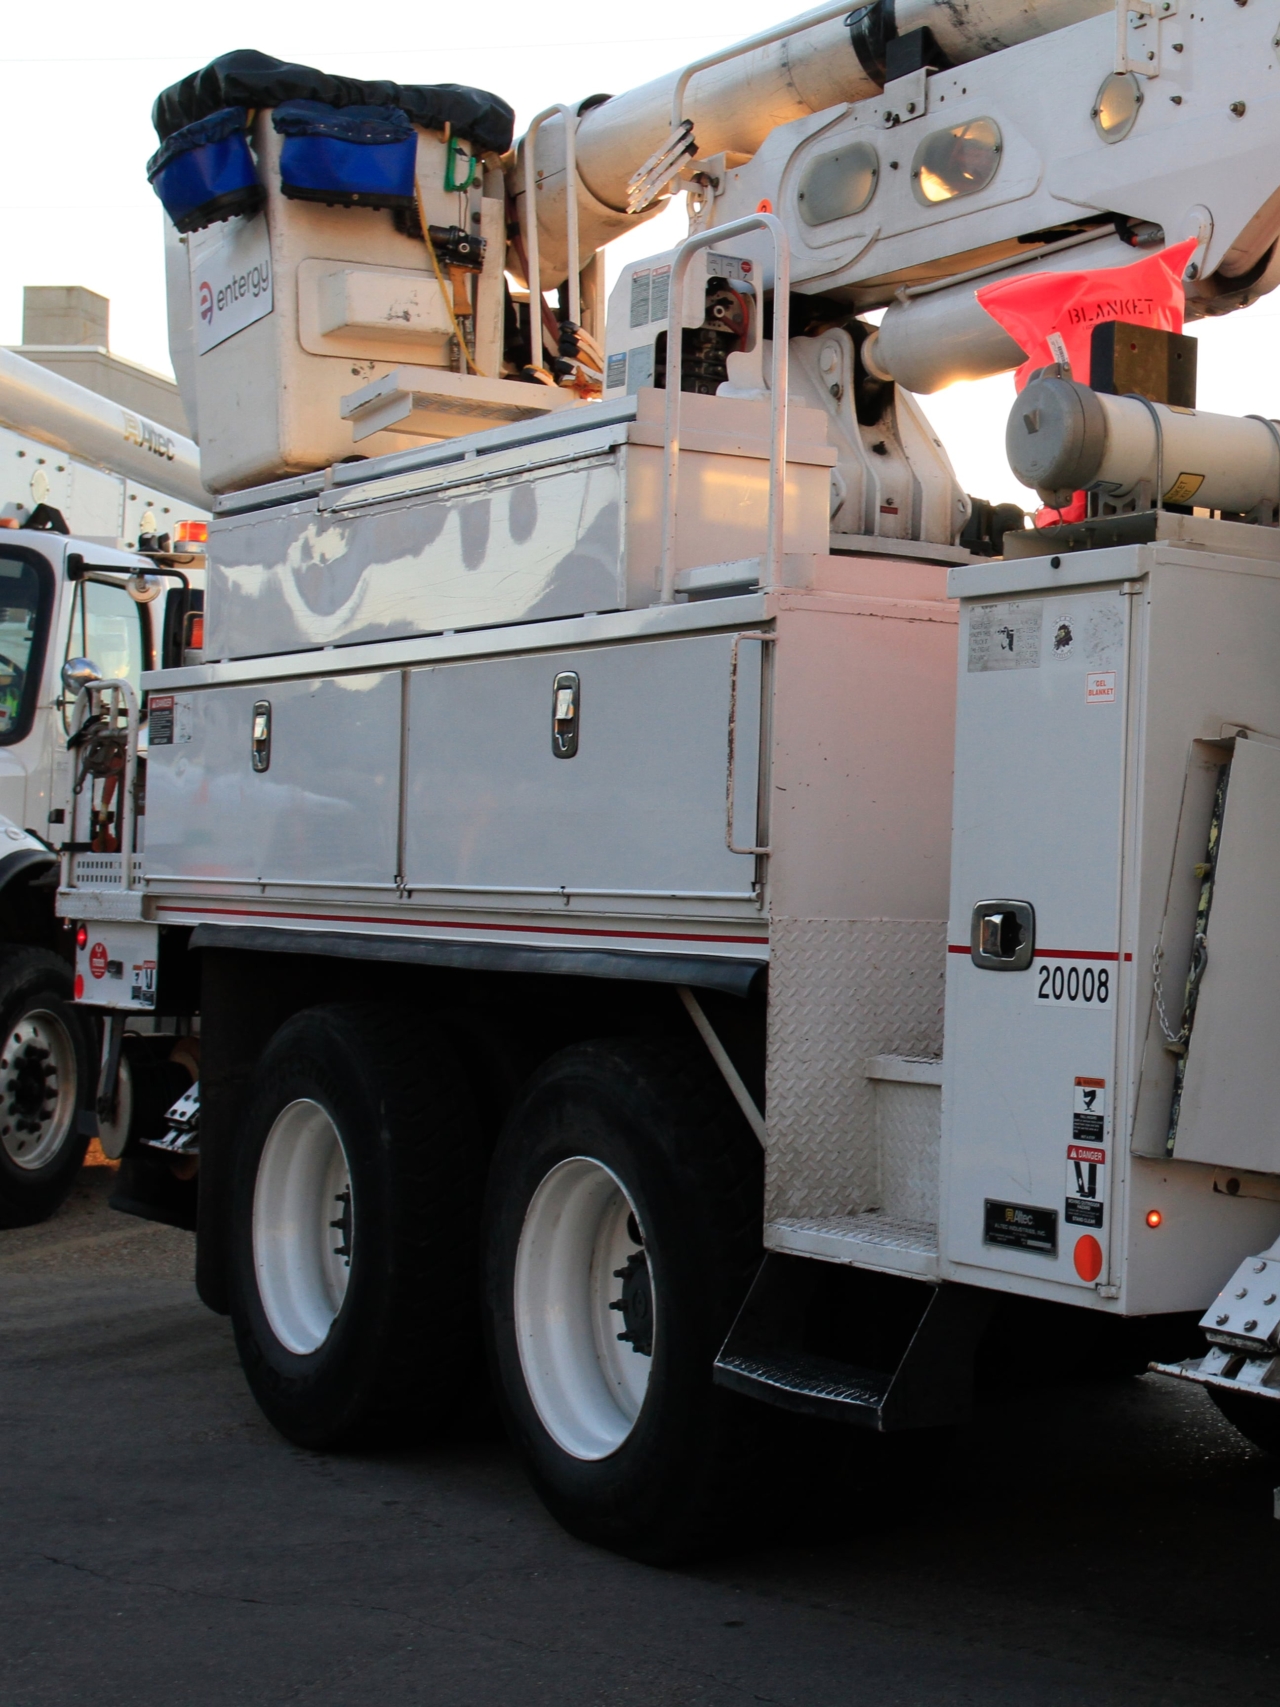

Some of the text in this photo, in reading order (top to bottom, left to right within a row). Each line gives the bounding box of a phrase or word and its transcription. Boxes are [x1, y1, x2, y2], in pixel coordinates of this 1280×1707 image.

[216, 259, 269, 311] entergy
[1067, 298, 1154, 325] BLANKET
[1088, 688, 1114, 696] BLANKET
[1038, 964, 1109, 1004] 20008
[1078, 1149, 1103, 1161] DANGER
[1014, 1209, 1034, 1225] Altec
